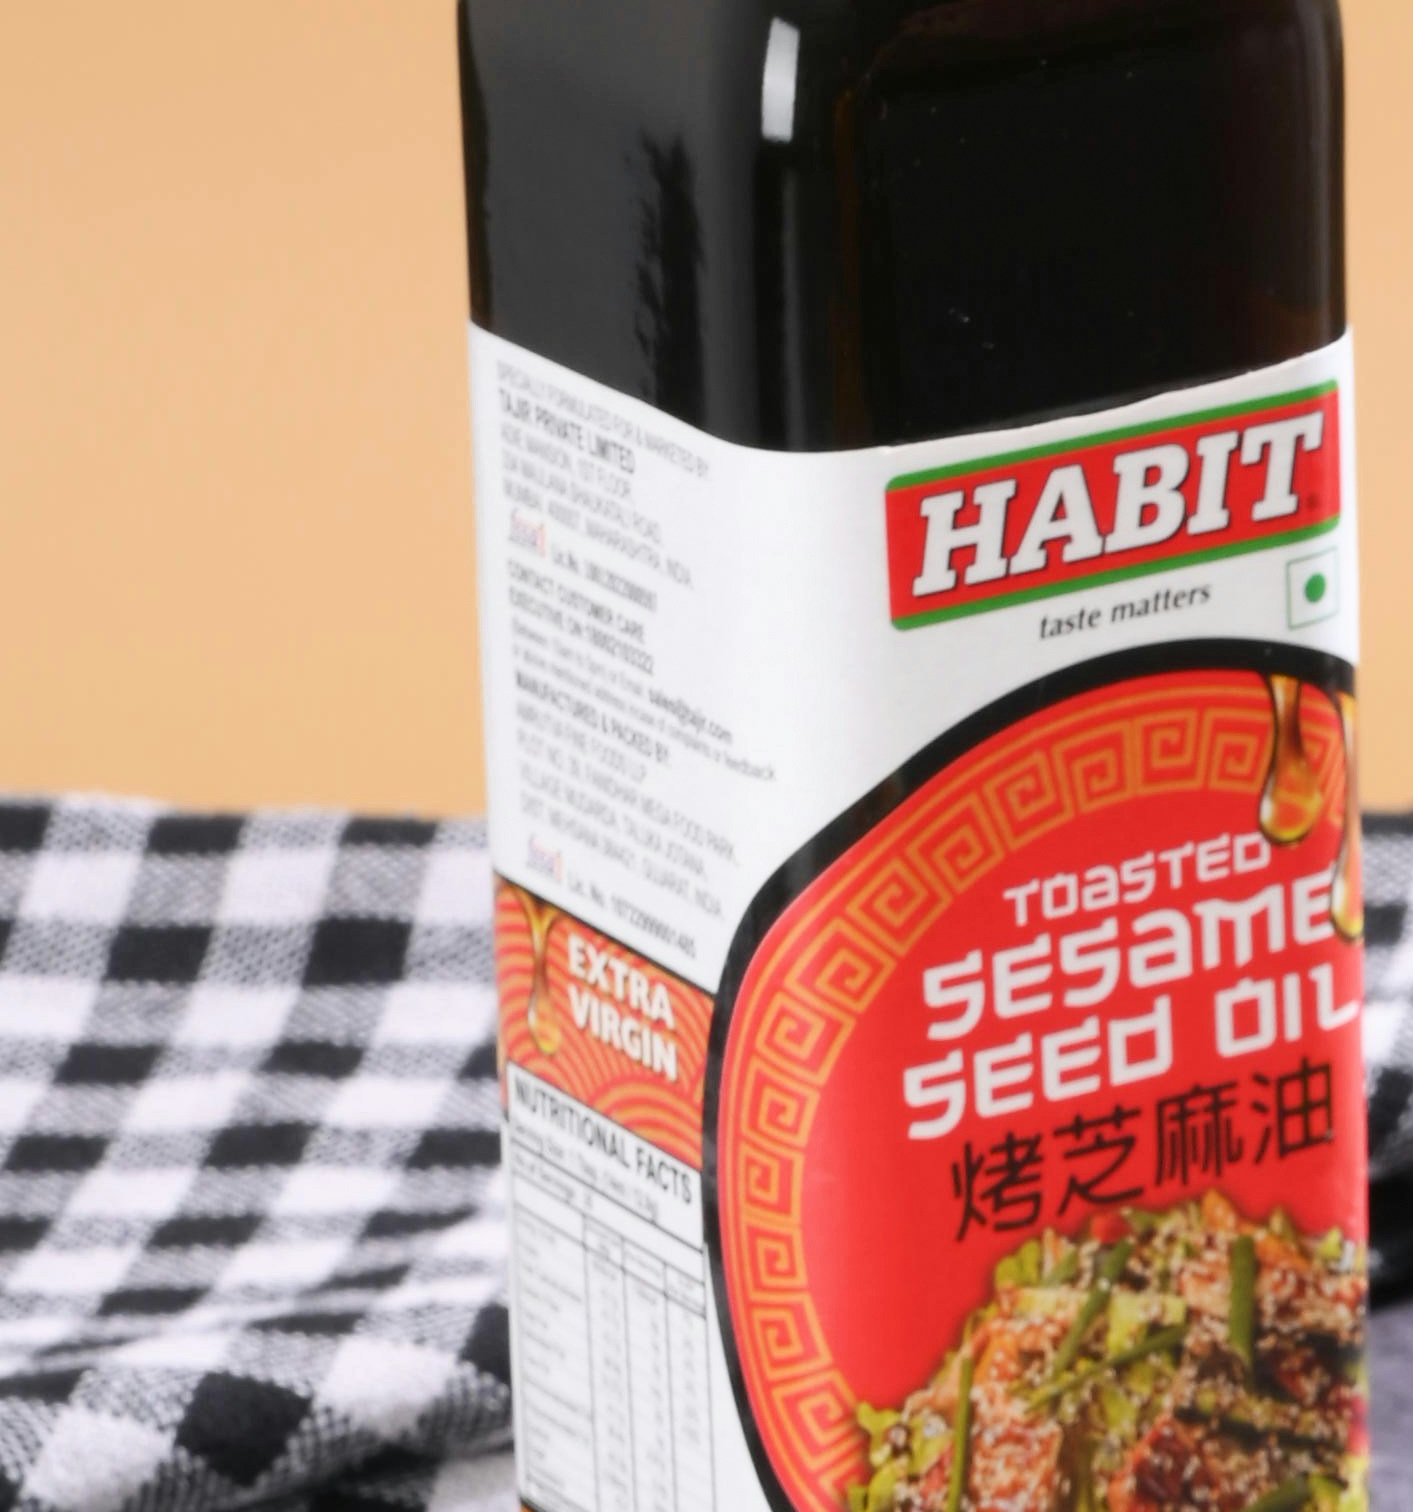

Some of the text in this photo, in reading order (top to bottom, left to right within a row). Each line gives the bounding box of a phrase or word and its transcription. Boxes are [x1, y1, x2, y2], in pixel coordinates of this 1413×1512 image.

[912, 410, 1323, 596] HABIT
[1038, 583, 1211, 640] taste matters
[1003, 832, 1270, 927] TOASTED
[568, 933, 676, 1030] EXTRA
[922, 863, 1335, 1040] SESAME
[568, 983, 678, 1081] VIRGIN
[904, 963, 1359, 1140] SEED OIL
[514, 1076, 630, 1168] NUTRITIONAL
[637, 1147, 692, 1204] FACTS
[951, 1056, 1334, 1242] 烤芝麻油
